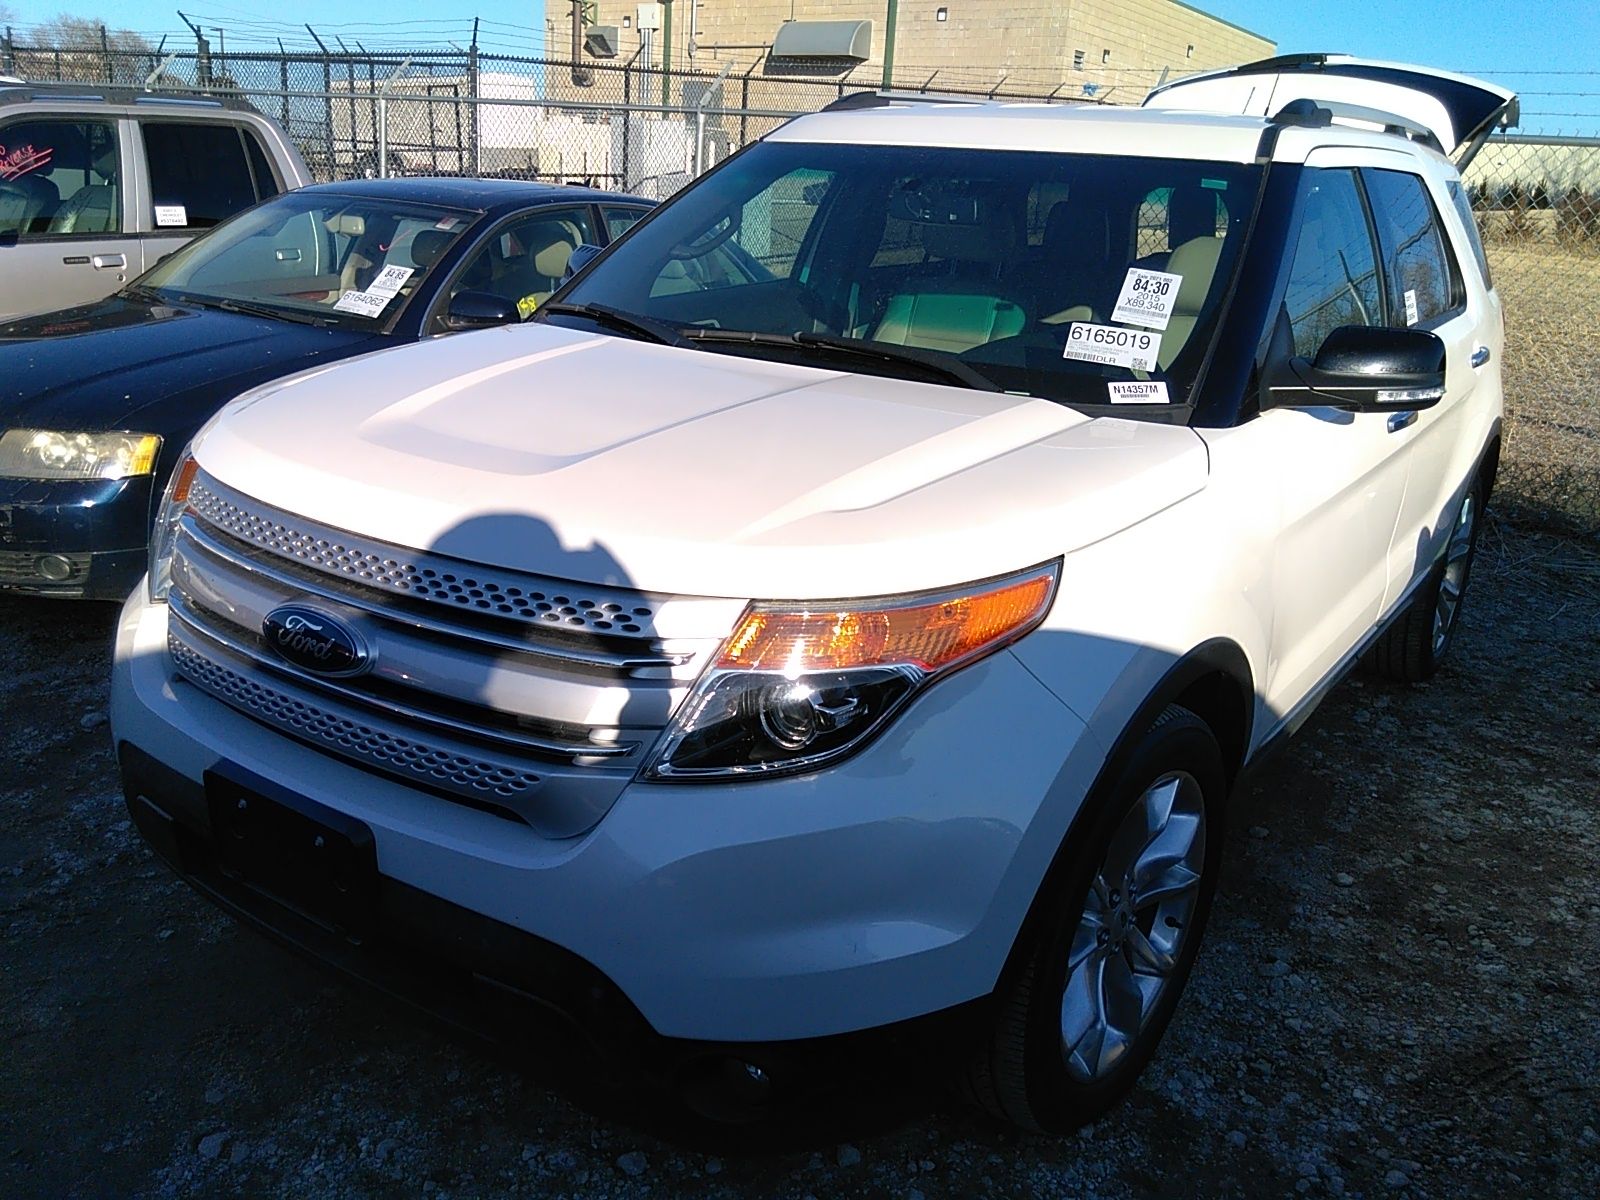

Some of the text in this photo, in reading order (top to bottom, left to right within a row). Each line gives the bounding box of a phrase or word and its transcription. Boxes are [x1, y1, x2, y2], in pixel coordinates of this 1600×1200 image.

[1132, 278, 1170, 296] 84:30
[343, 292, 384, 307] 6164062
[1136, 291, 1161, 302] 2015
[1071, 326, 1151, 350] 6165019
[1113, 384, 1159, 394] N14357M
[277, 615, 336, 660] Ford
